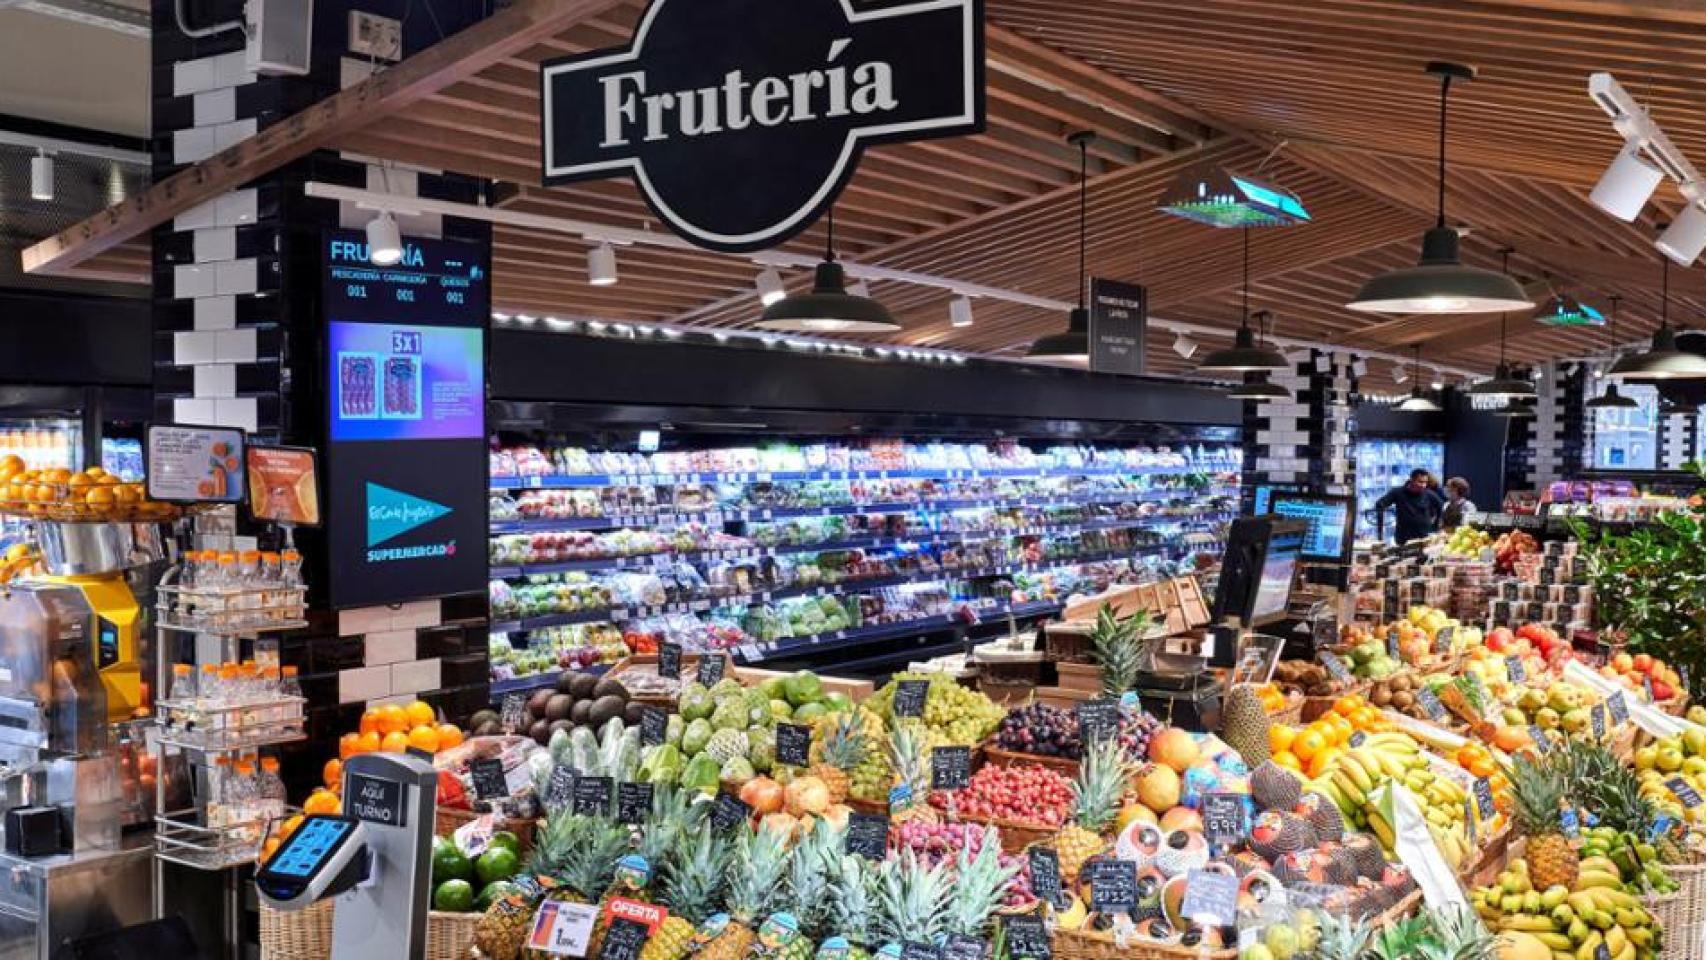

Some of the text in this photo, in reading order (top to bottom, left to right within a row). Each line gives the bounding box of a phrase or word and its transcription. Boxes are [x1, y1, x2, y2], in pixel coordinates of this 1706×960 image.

[599, 37, 899, 147] Frutería
[347, 285, 464, 304] 001 001 001
[353, 802, 391, 820] TURNO
[611, 900, 660, 919] OFERTA
